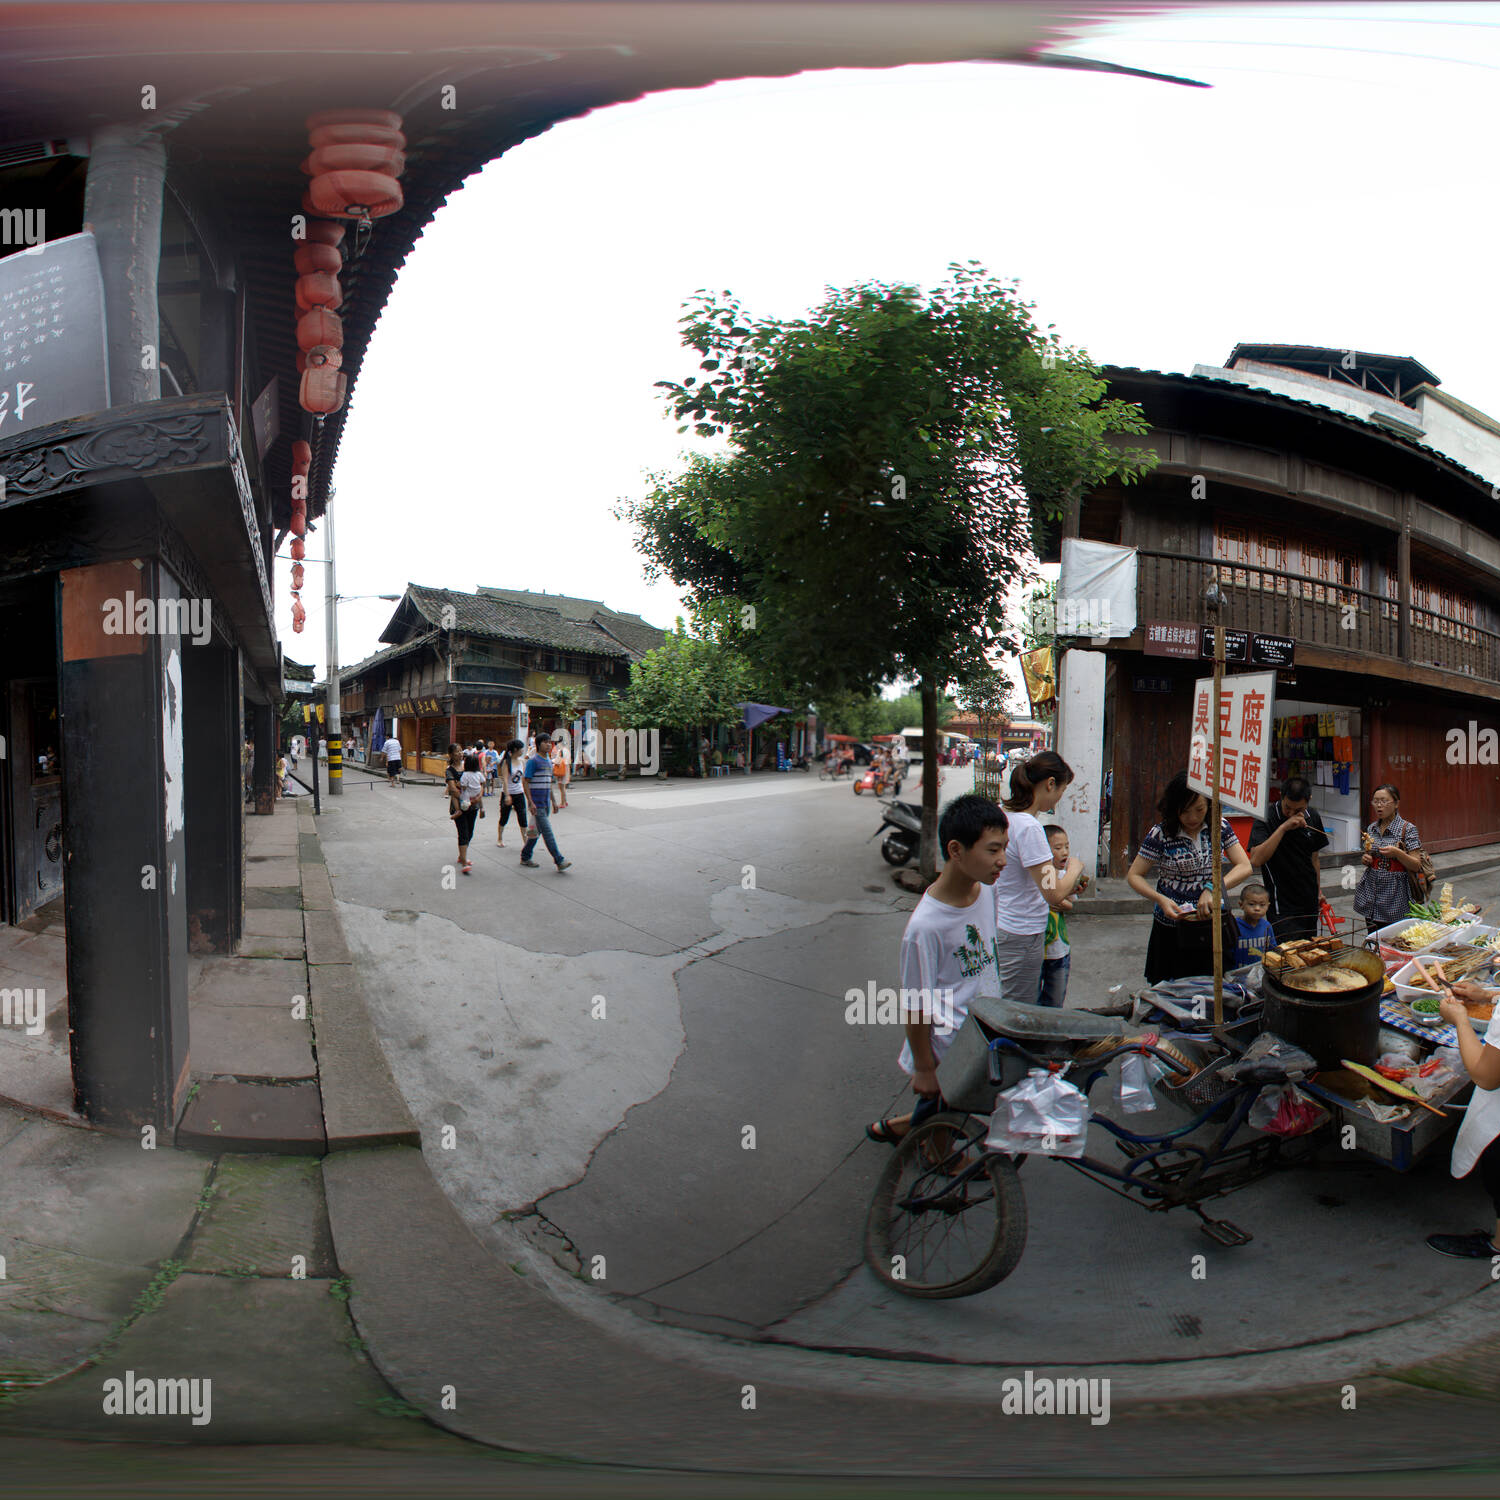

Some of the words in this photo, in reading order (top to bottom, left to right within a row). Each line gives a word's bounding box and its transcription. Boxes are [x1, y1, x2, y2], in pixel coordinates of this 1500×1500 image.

[1195, 688, 1265, 745] 臭豆腐
[1190, 741, 1261, 808] 五香豆腐
